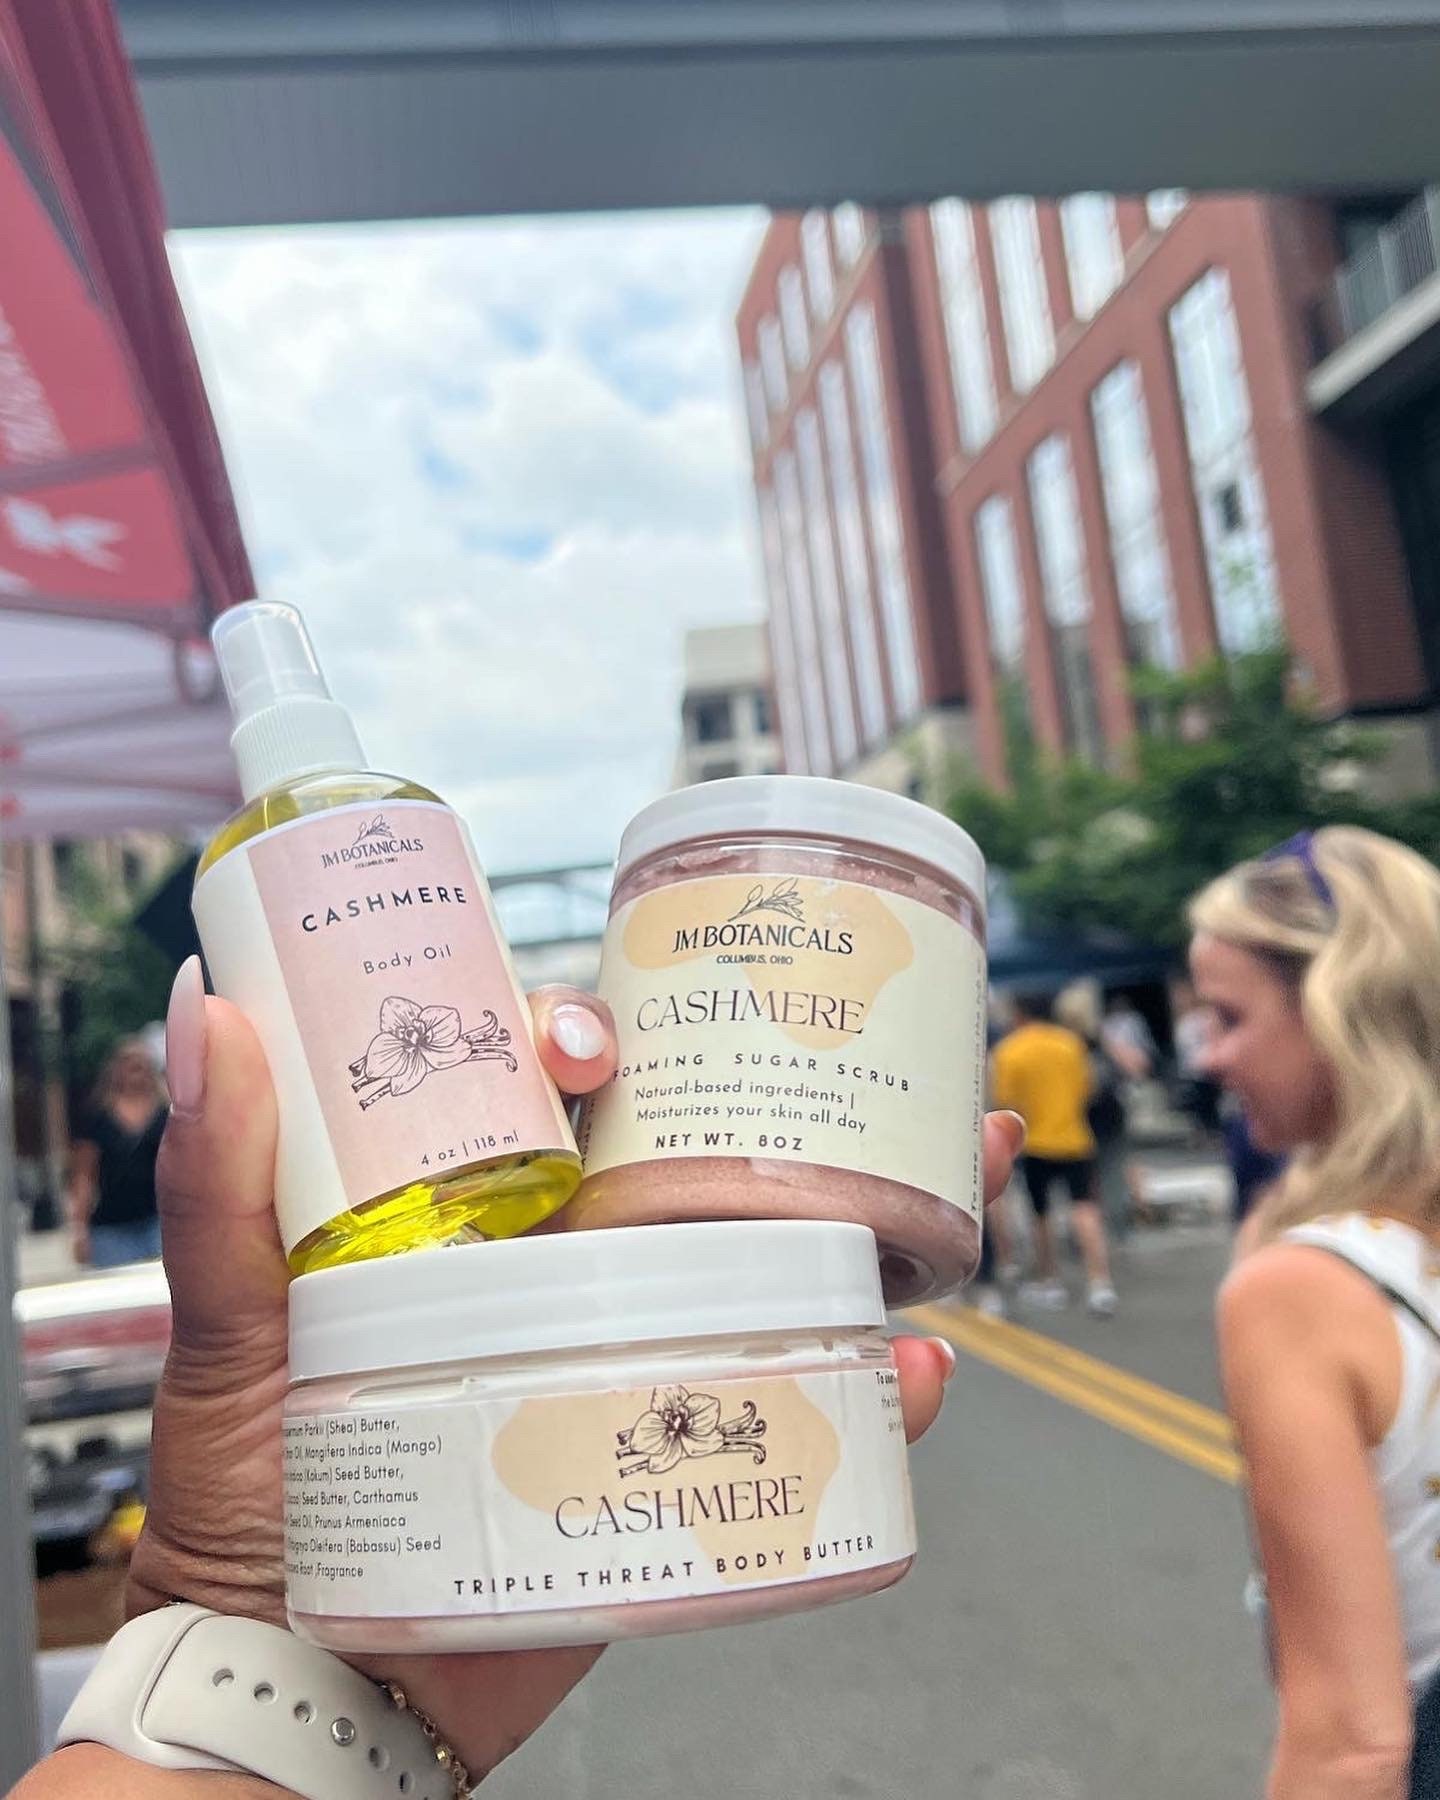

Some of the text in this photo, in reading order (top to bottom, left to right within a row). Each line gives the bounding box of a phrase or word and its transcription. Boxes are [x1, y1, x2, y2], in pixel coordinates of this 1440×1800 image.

[321, 838, 424, 869] JM BOTANICALS
[302, 886, 468, 932] CASHMERE
[672, 924, 853, 955] JM BOTANICALS
[363, 943, 452, 975] Body Oil
[769, 955, 793, 966] OHIO
[636, 989, 864, 1035] CASHMERE
[734, 1053, 817, 1071] SUGAR
[837, 1063, 909, 1092] SCRUB
[634, 1078, 742, 1101] Natural-based
[749, 1082, 843, 1103] ingredients
[636, 1103, 866, 1133] Moisturizes your skin all day
[421, 1153, 430, 1166] 4
[438, 1147, 457, 1162] oz
[473, 1134, 496, 1149] 118
[502, 1129, 519, 1145] ml
[655, 1133, 691, 1149] NET
[704, 1132, 743, 1146] WT.
[326, 1420, 357, 1438] (Shea)
[360, 1418, 400, 1433] Butter,
[348, 1444, 381, 1457] Indica
[386, 1435, 442, 1459] (Mango)
[335, 1466, 360, 1481] Seed
[364, 1465, 404, 1481] Butter,
[302, 1491, 319, 1506] Seed
[320, 1491, 350, 1507] Butter,
[353, 1488, 419, 1505] Carthamus
[555, 1475, 806, 1539] CASHMERE
[315, 1514, 342, 1529] Prunus
[345, 1515, 406, 1529] Armeniaca
[346, 1537, 401, 1557] (Babassu)
[406, 1534, 442, 1551] Seed
[454, 1535, 874, 1597] TRIPLE THREAT BODY BUTTER
